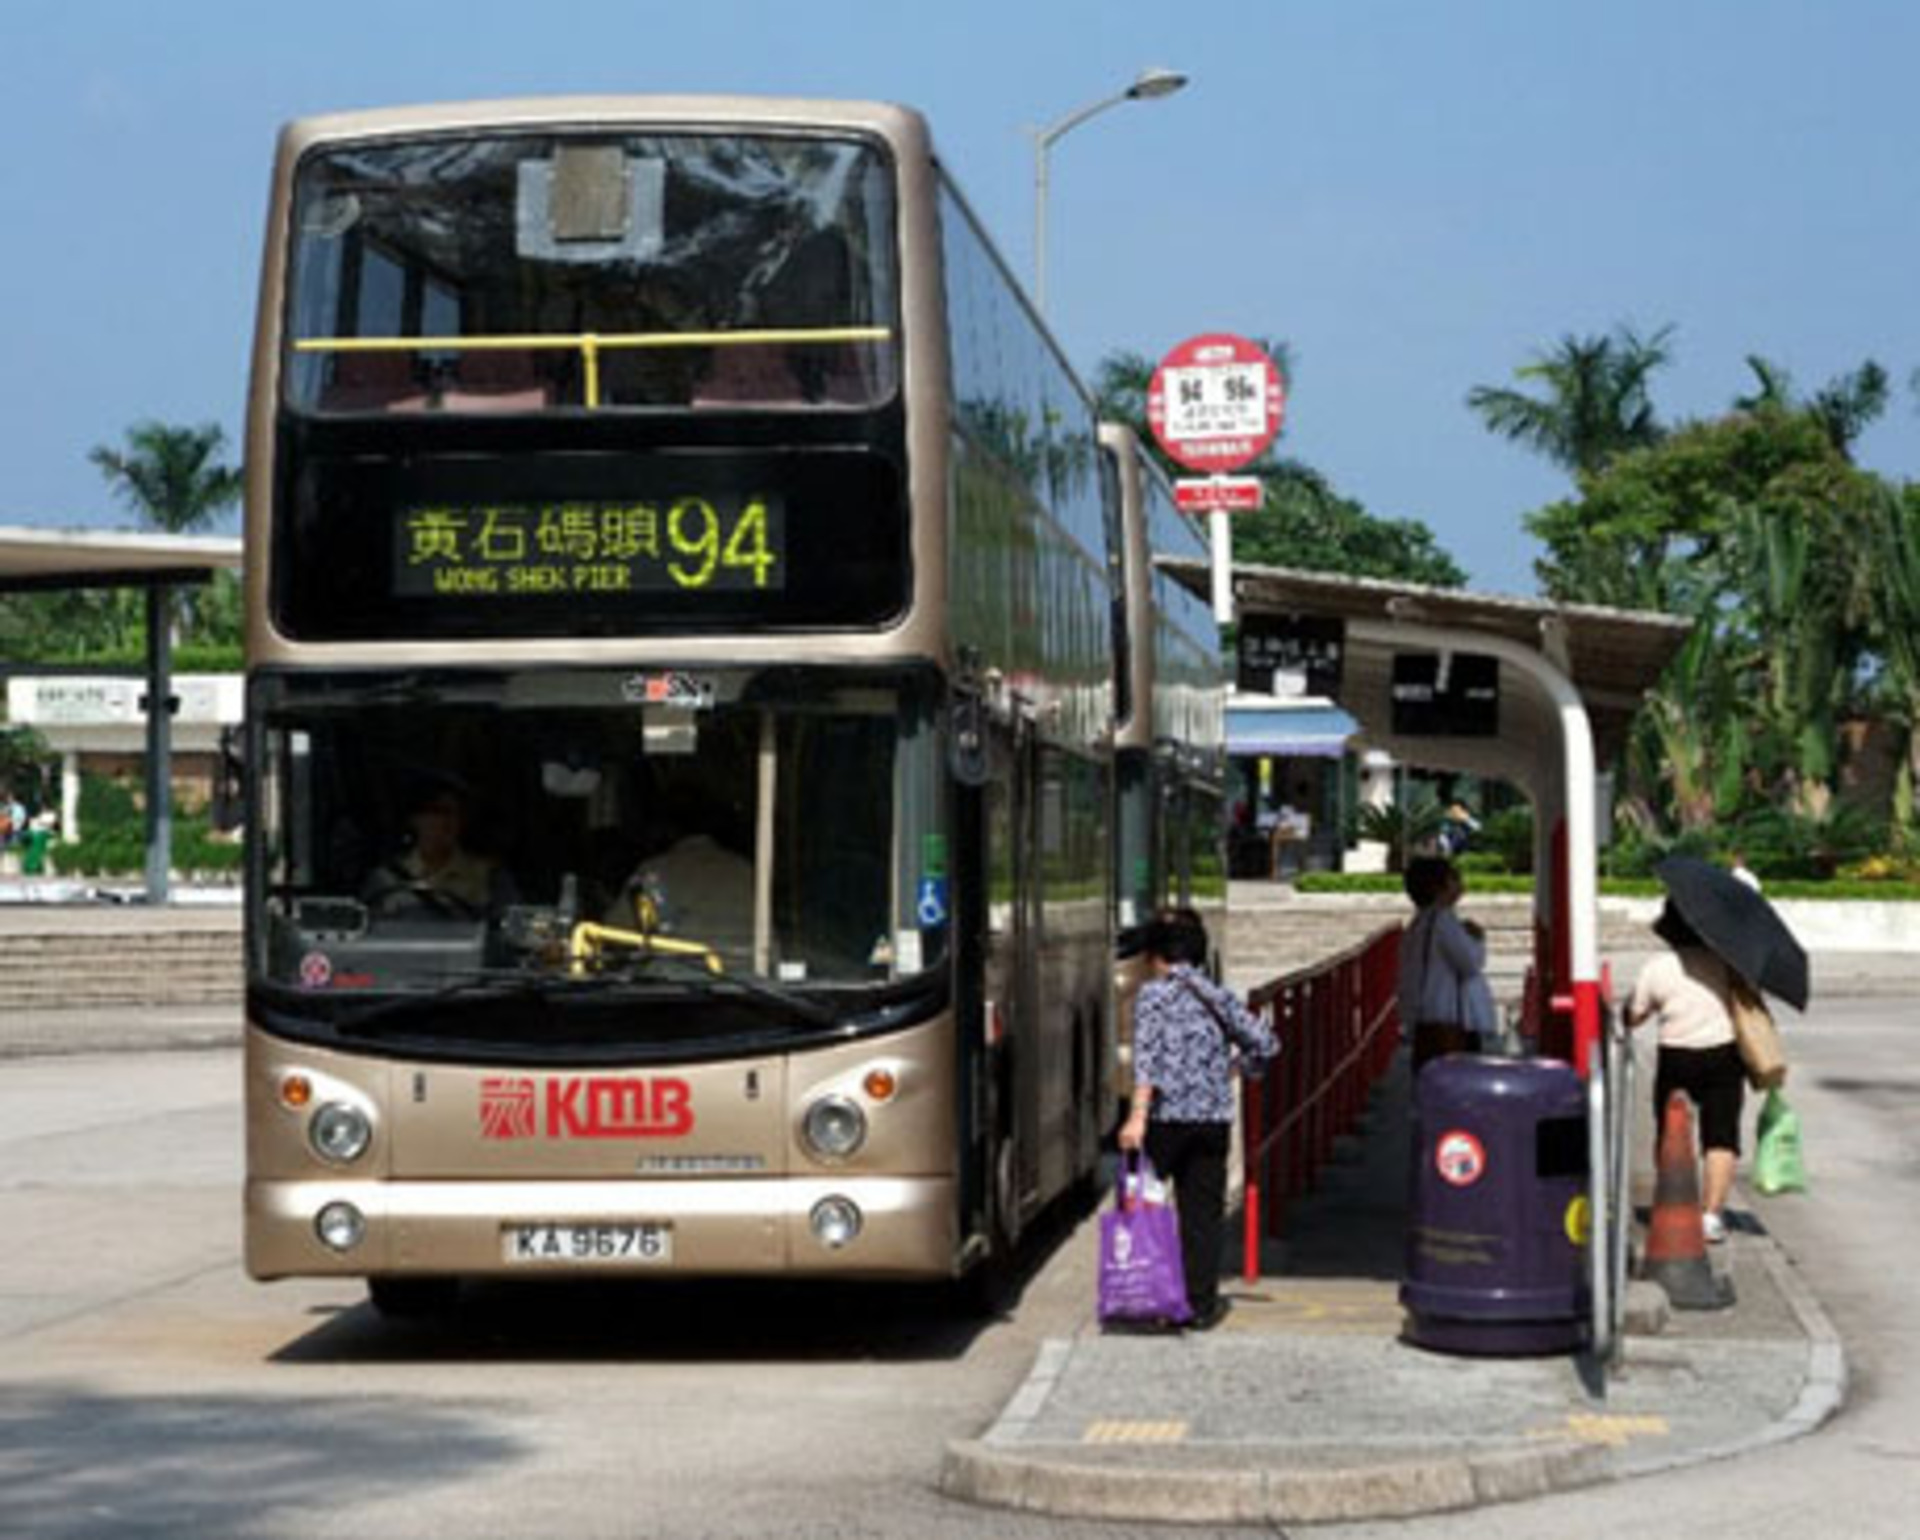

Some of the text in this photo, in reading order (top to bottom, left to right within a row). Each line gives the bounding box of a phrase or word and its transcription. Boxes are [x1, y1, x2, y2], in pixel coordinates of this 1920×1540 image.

[667, 499, 775, 588] 94
[433, 565, 632, 593] WONG SHEK PIER
[545, 1077, 694, 1138] KMB
[518, 1224, 560, 1255] KA
